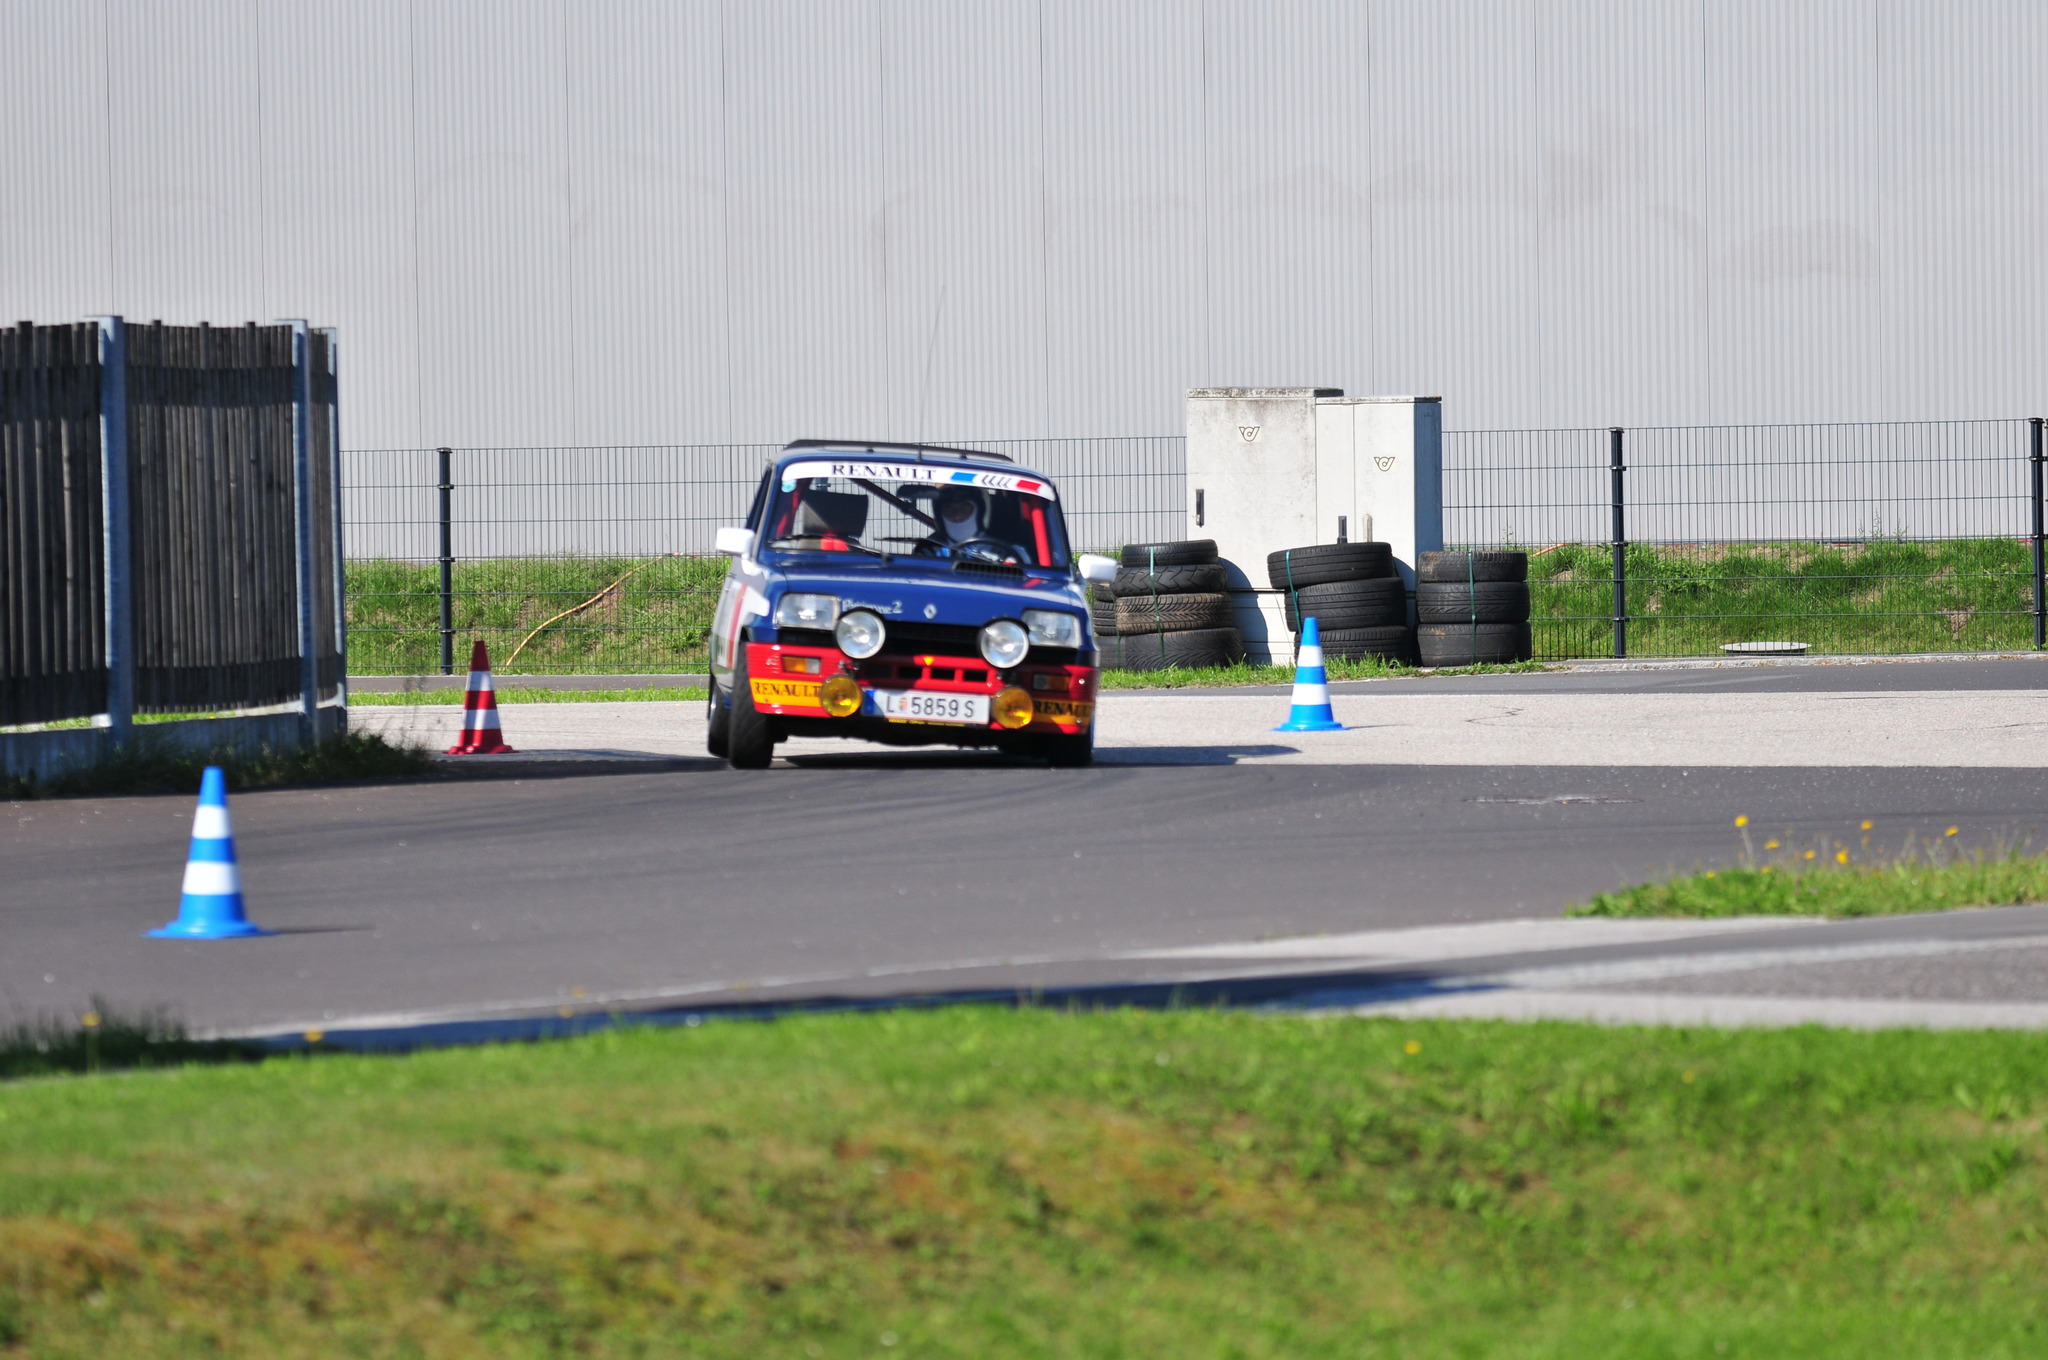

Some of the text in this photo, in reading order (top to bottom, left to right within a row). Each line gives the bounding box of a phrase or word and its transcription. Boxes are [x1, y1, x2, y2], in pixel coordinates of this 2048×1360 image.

[832, 464, 937, 481] RENAULT
[754, 682, 821, 698] RENAULT
[886, 696, 895, 713] L
[911, 697, 959, 717] 5859
